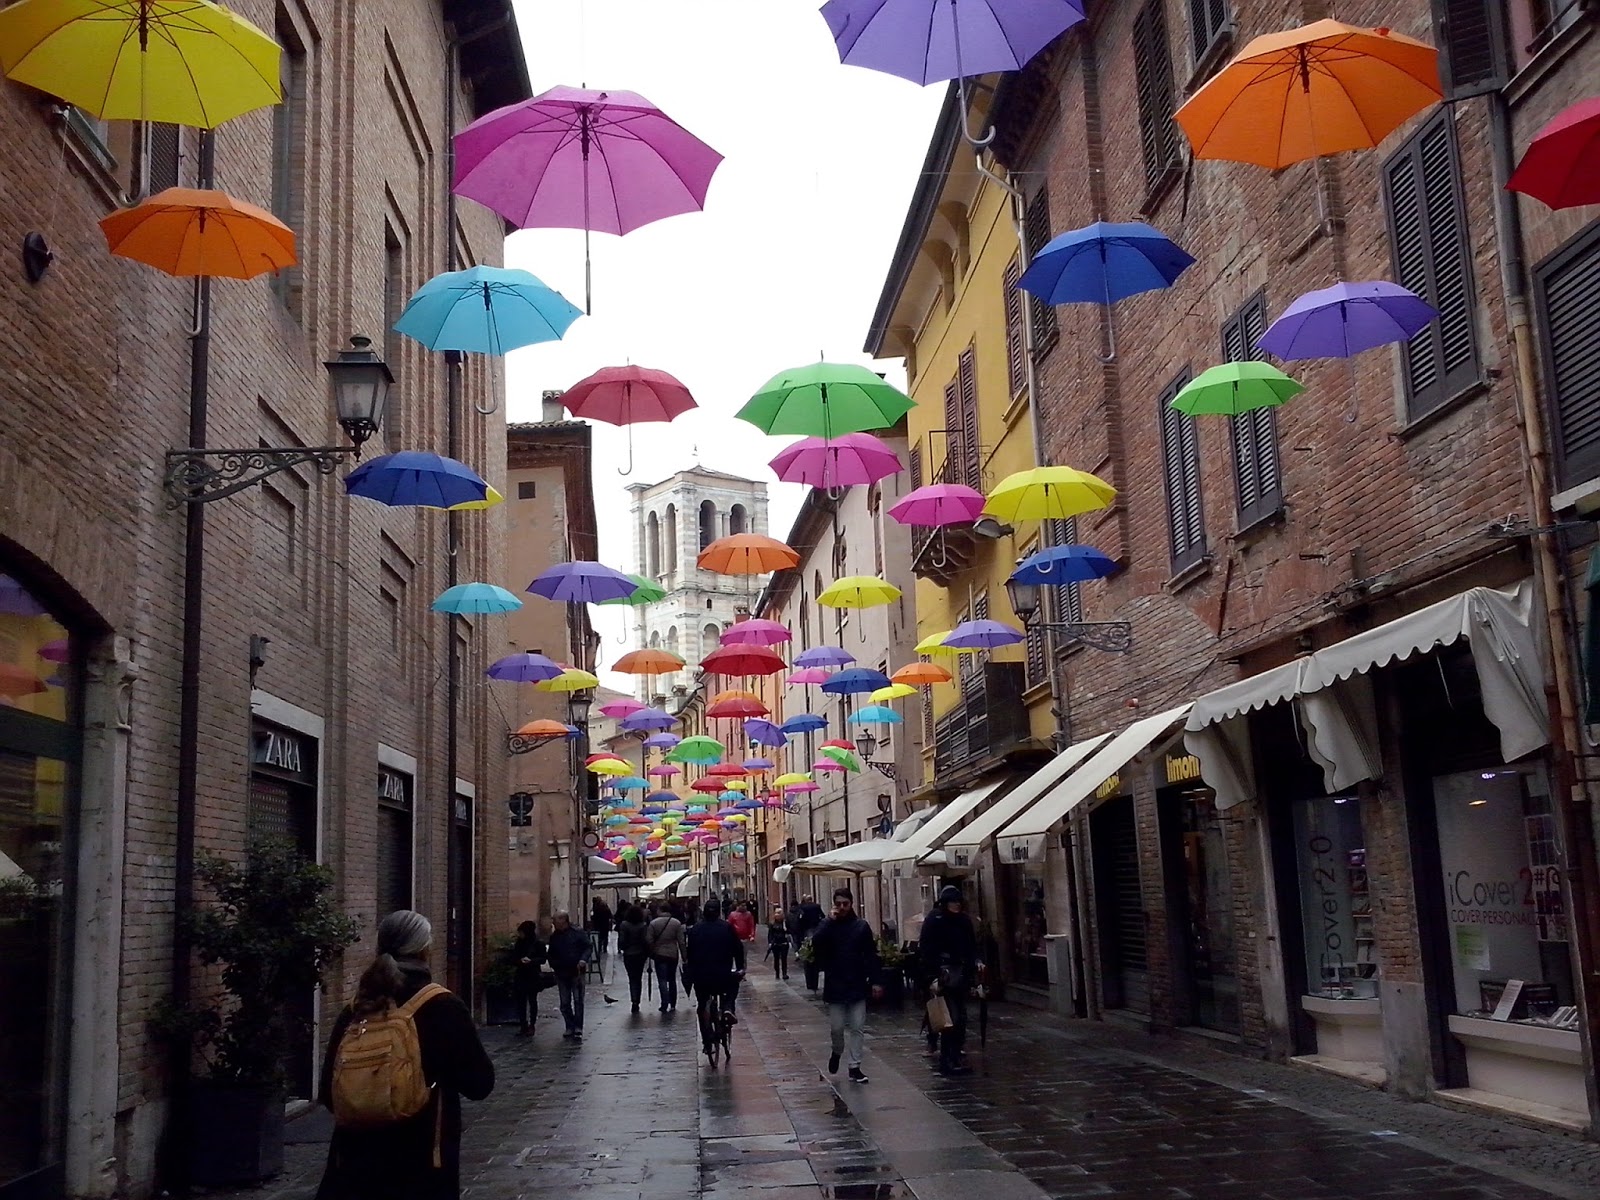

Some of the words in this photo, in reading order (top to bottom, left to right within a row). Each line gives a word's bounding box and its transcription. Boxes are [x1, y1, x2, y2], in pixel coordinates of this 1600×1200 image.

[265, 731, 301, 773] ZARA
[1165, 753, 1201, 783] limoni
[383, 773, 405, 803] ZARA
[1309, 836, 1344, 984] Cover2.0
[1451, 909, 1481, 923] COVER
